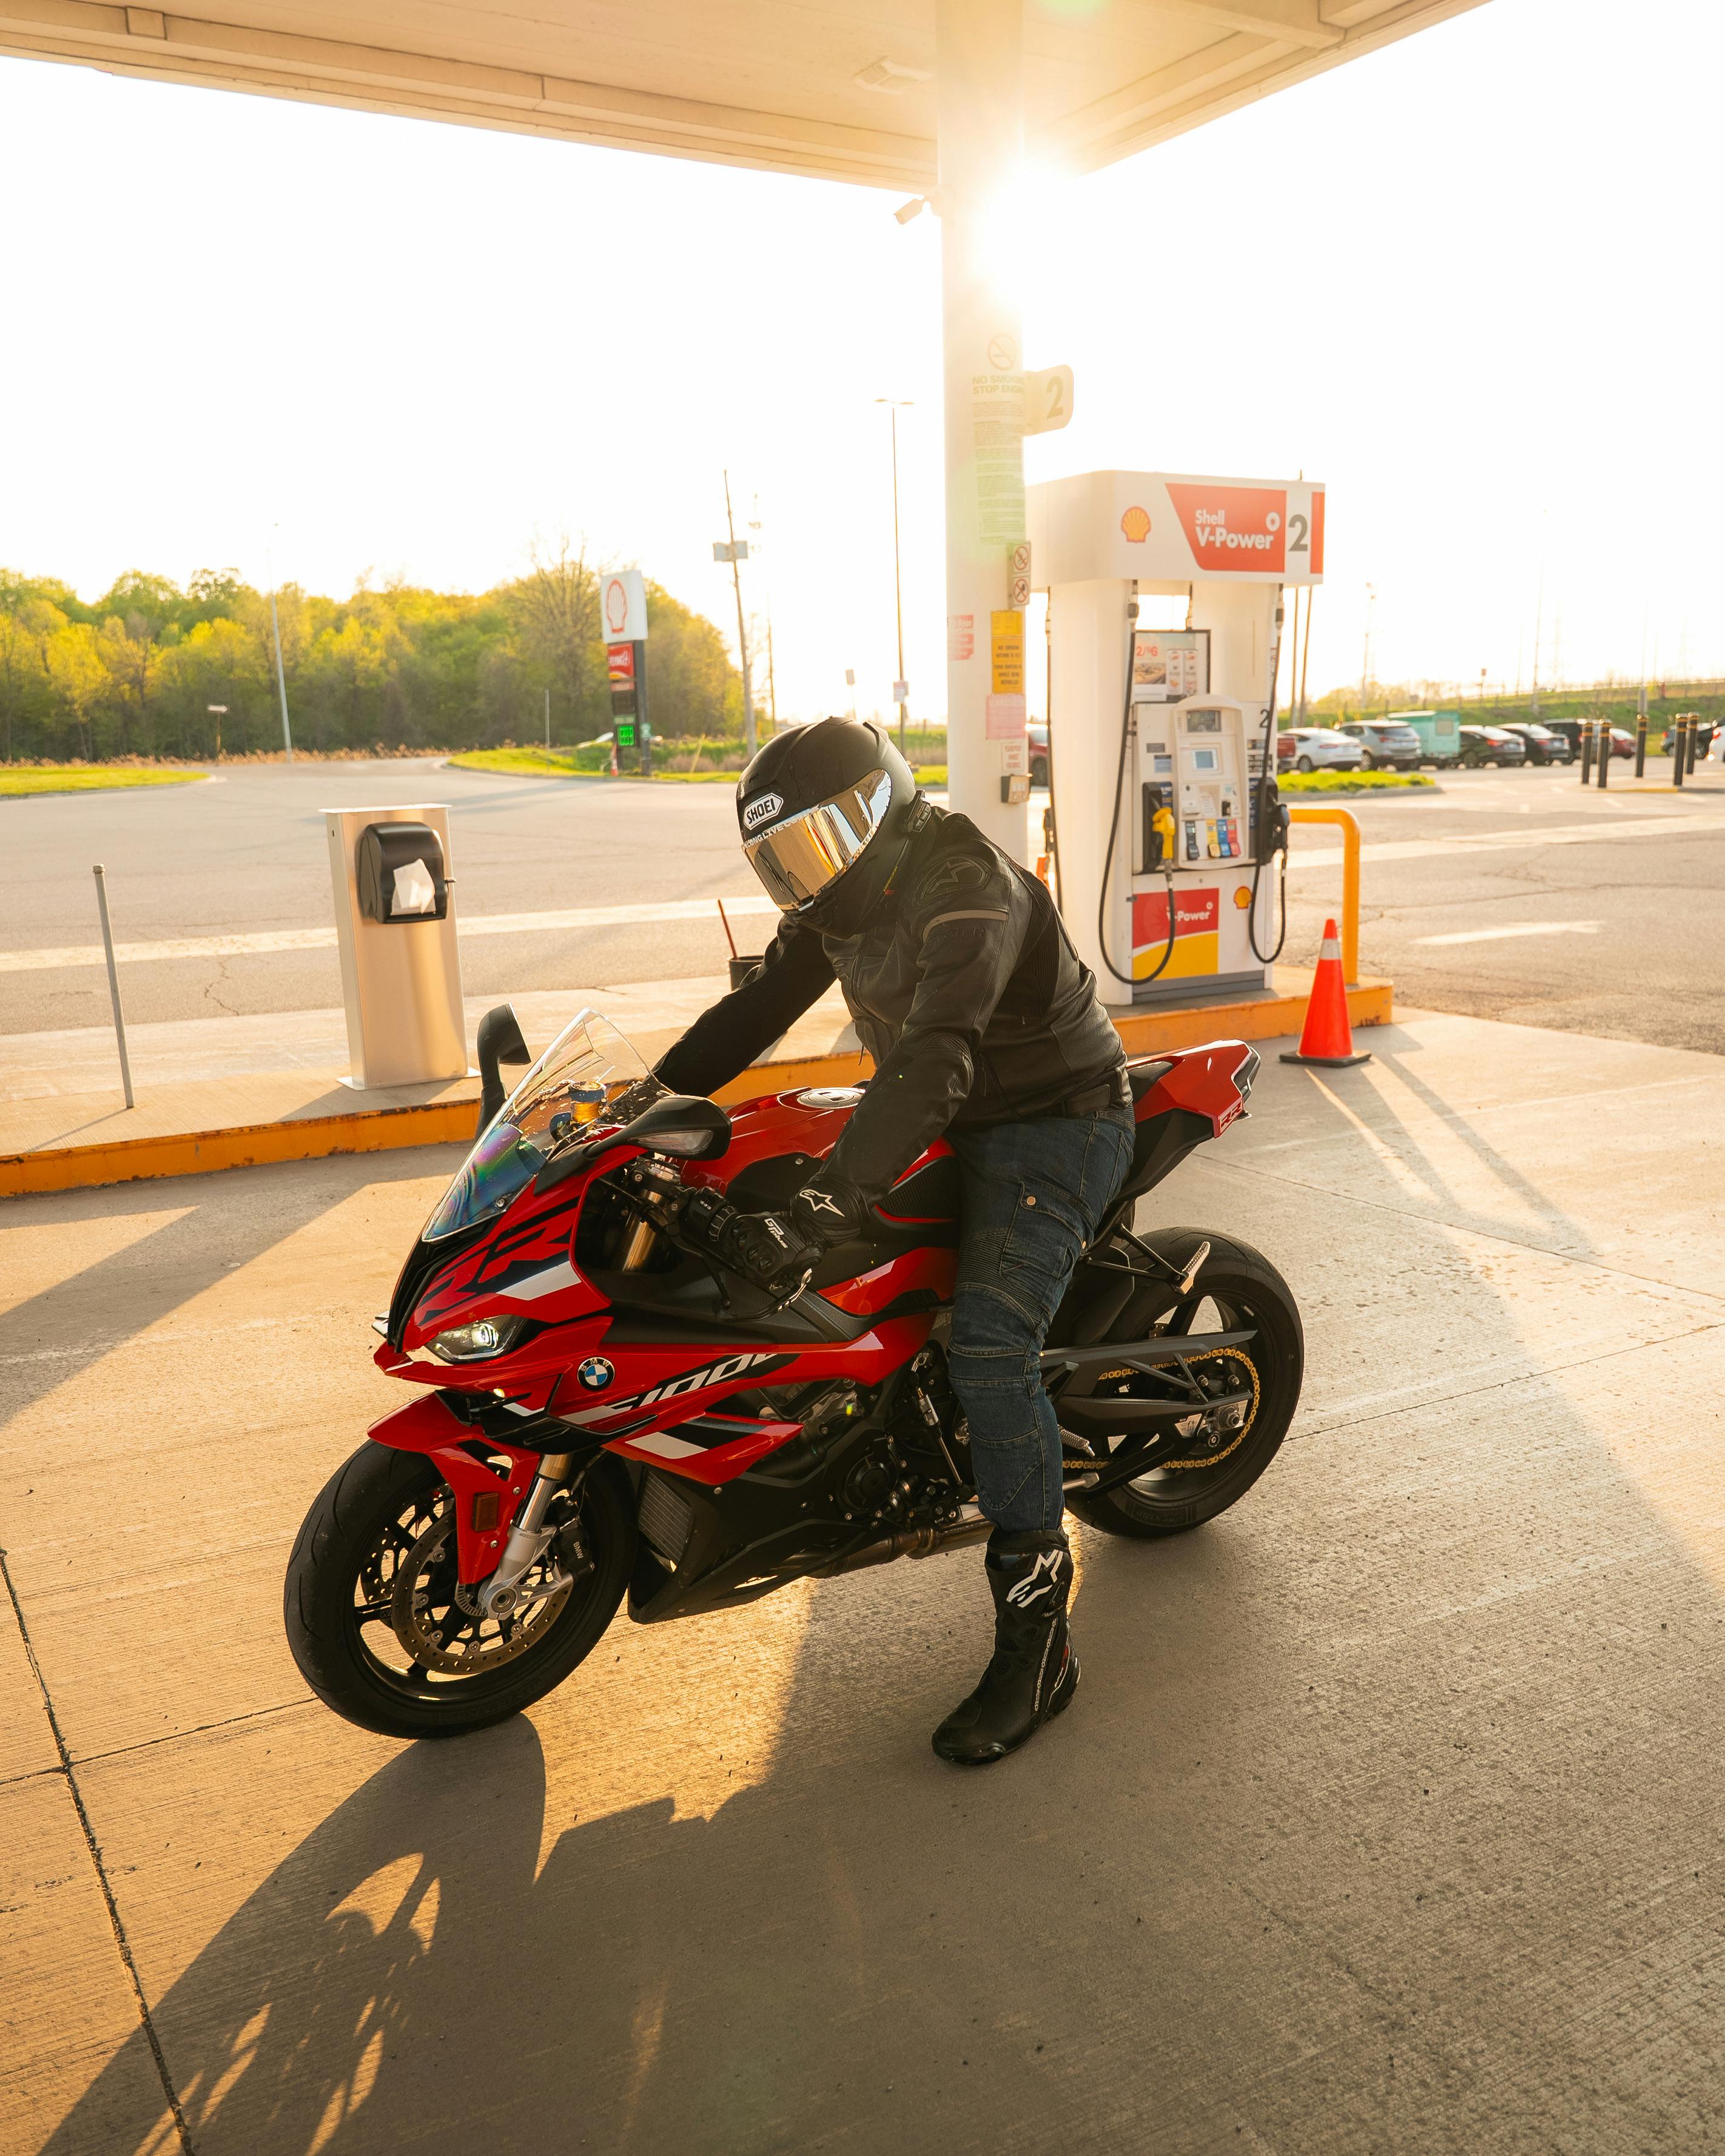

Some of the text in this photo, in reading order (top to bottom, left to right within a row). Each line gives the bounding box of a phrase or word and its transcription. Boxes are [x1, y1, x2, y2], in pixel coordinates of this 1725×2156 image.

[972, 375, 987, 385] NO
[972, 385, 1000, 394] STOP
[1046, 375, 1064, 419] 2
[1195, 509, 1225, 526] Shell
[1195, 526, 1274, 549] V-Power
[1288, 514, 1308, 552] 2
[1259, 709, 1271, 728] 2
[747, 798, 776, 824] SHOEI
[1221, 1102, 1242, 1127] RR
[579, 1358, 610, 1372] BMW
[573, 1541, 584, 1559] BMW
